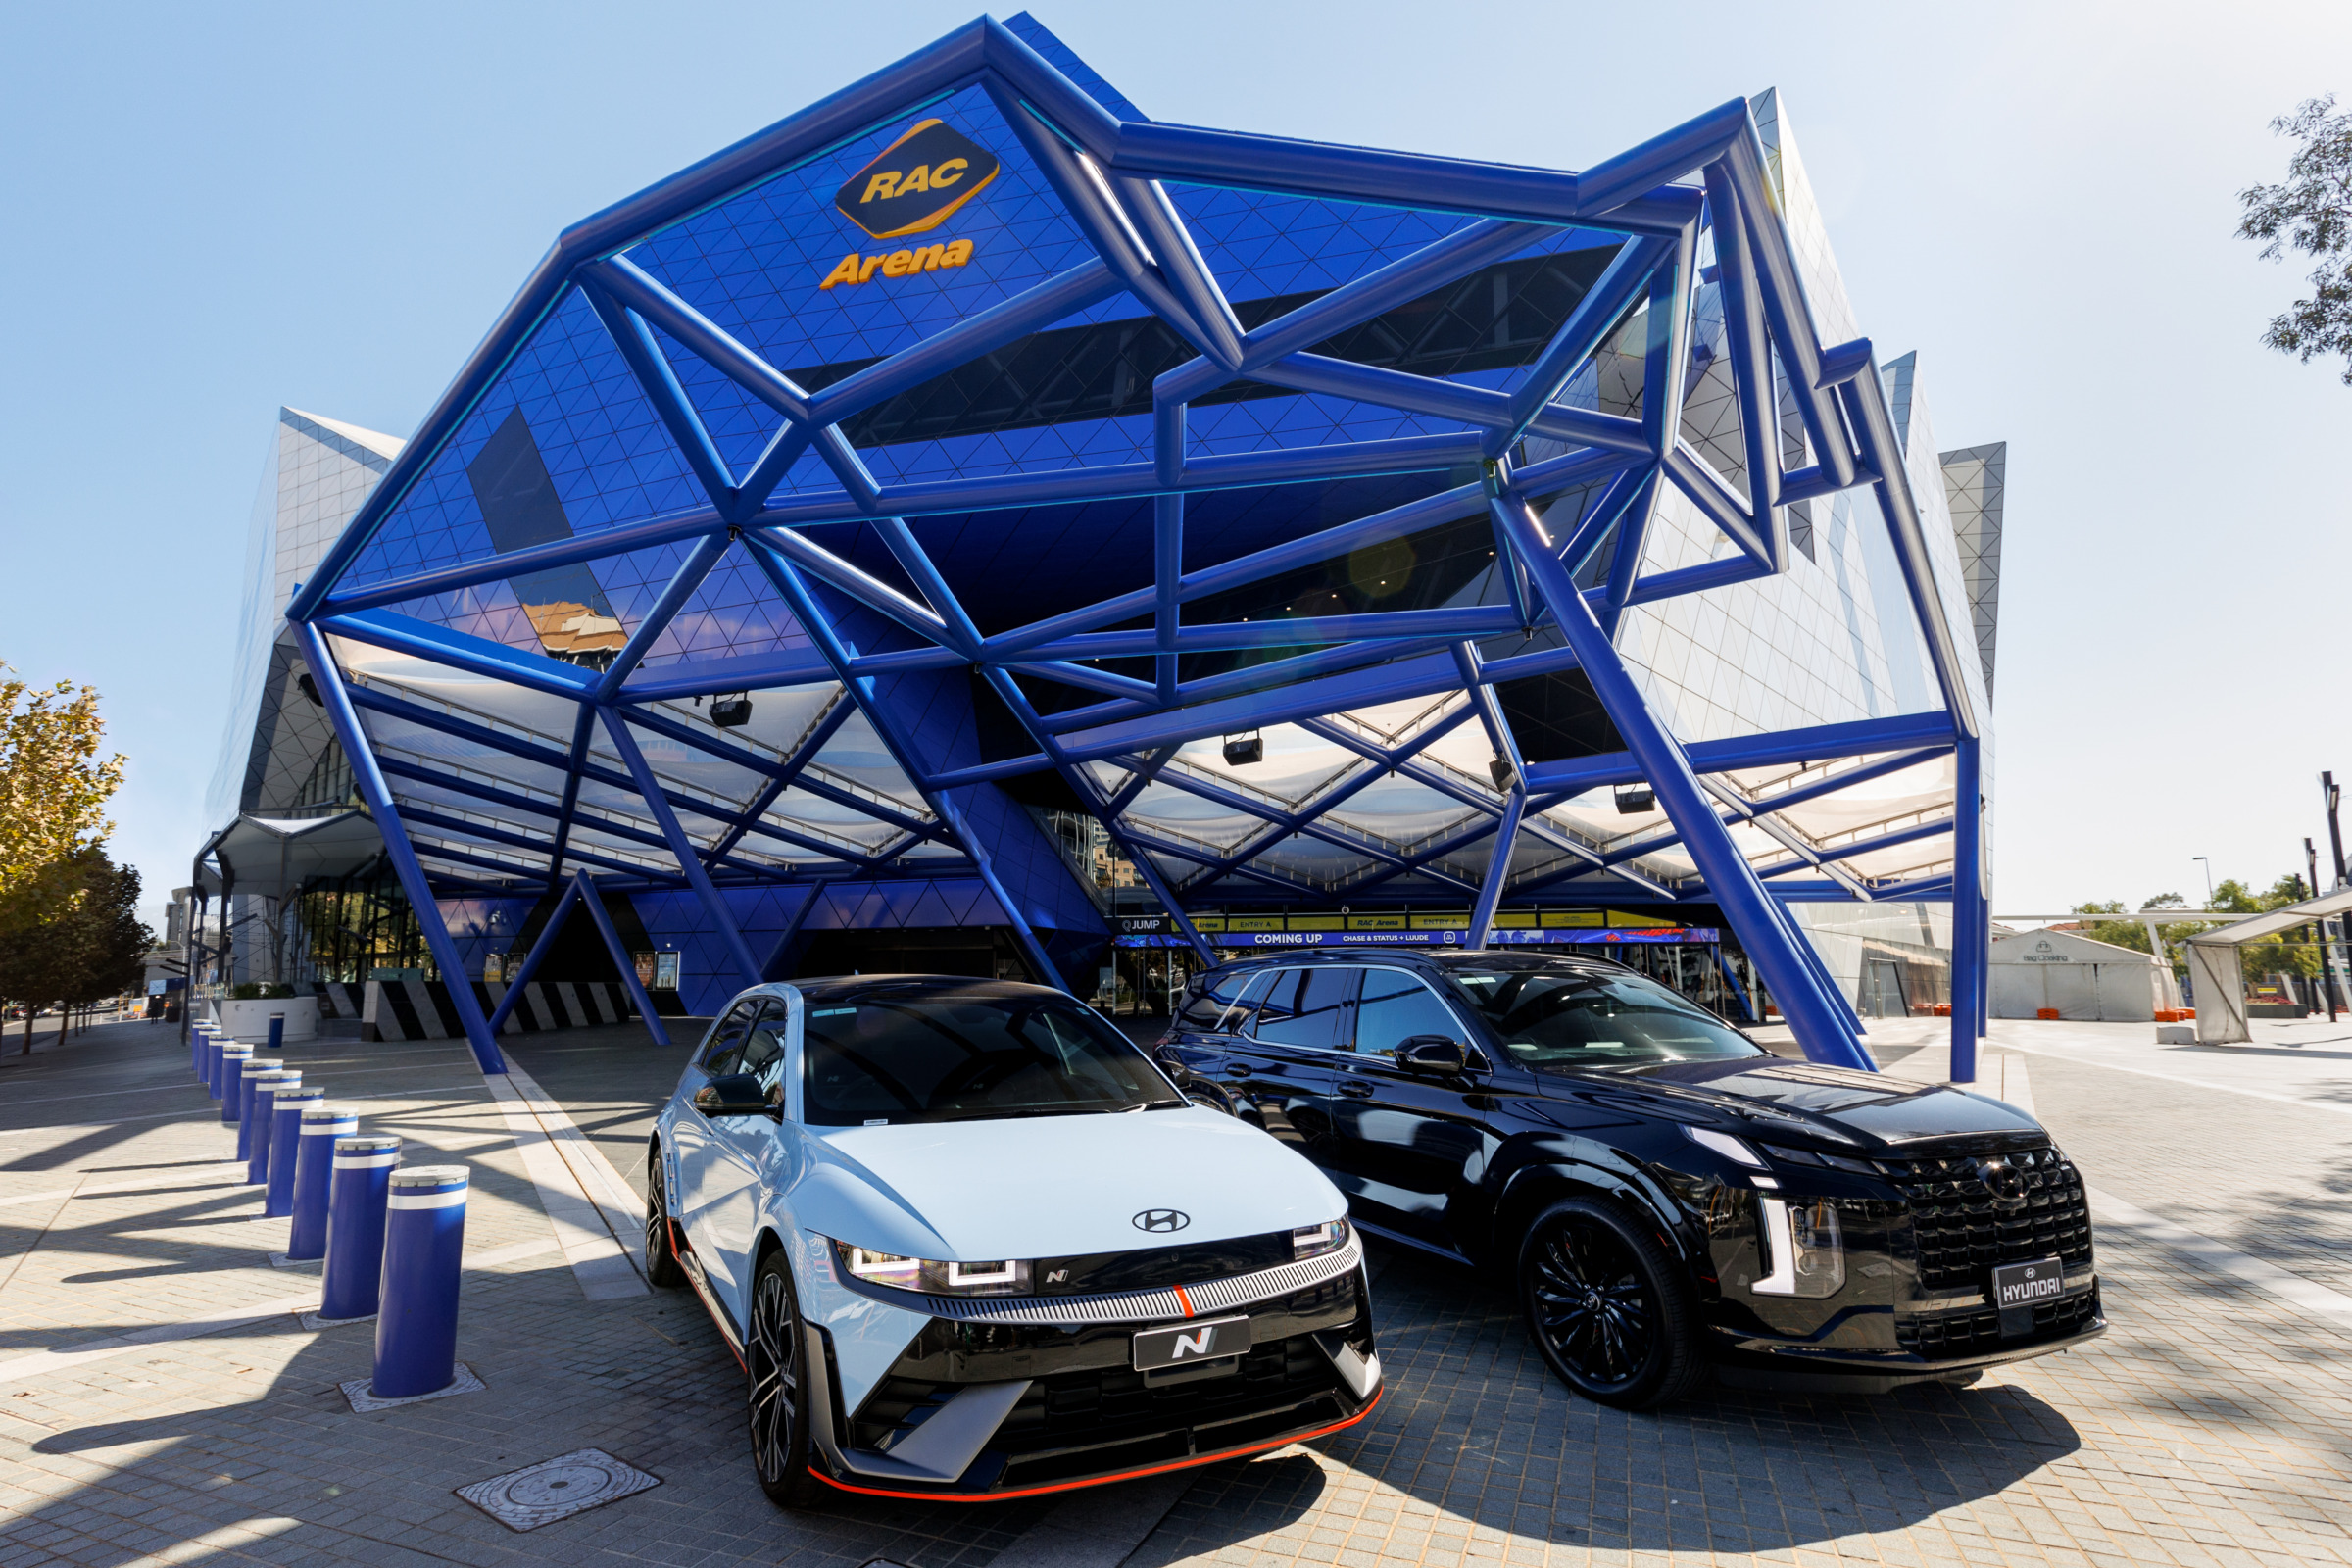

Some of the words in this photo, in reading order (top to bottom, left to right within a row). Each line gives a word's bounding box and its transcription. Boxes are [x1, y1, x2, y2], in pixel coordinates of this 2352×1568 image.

[859, 157, 969, 204] RAC
[819, 238, 974, 290] Arena
[1254, 934, 1303, 944] COMING
[1305, 934, 1323, 943] UP
[2003, 1277, 2061, 1302] HYUNDAI
